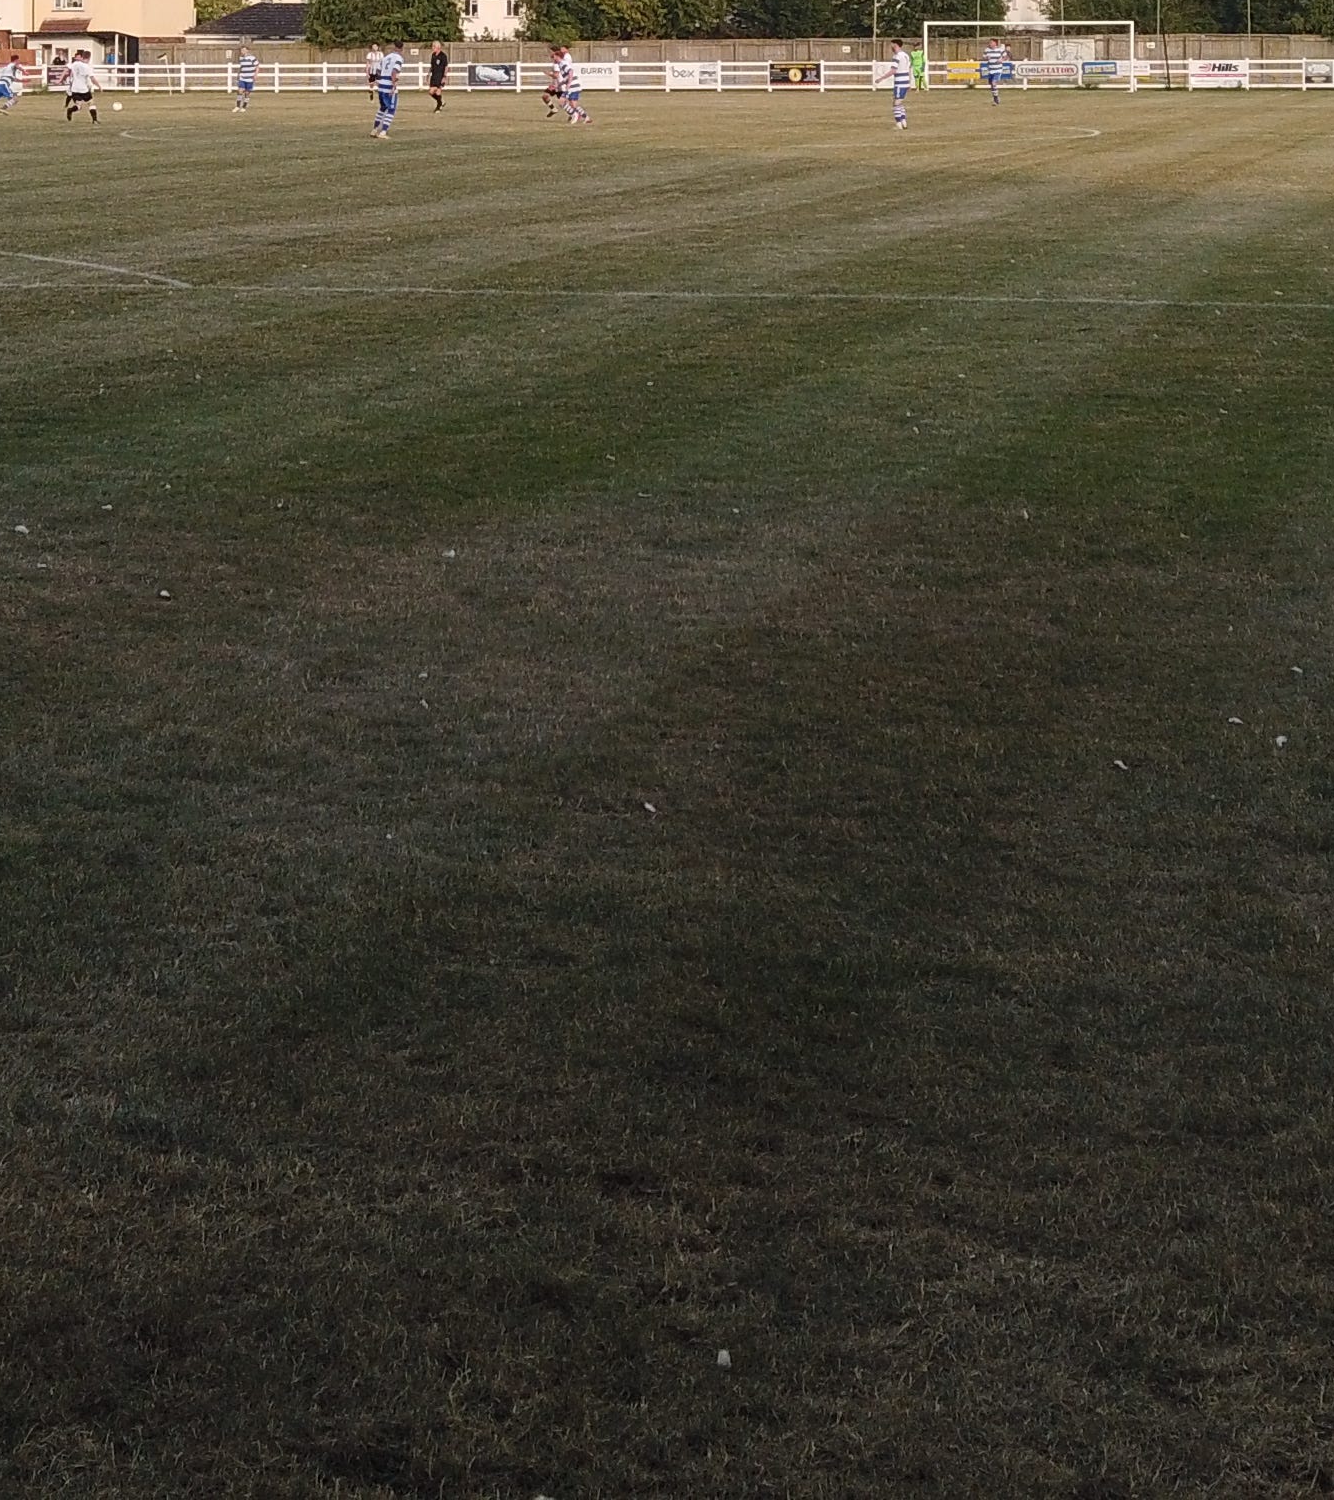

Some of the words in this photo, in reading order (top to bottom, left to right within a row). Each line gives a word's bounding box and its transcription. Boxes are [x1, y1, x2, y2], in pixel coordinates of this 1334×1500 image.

[671, 65, 695, 78] bex
[1019, 66, 1075, 74] TOOLSTATION
[1211, 63, 1240, 72] Hills
